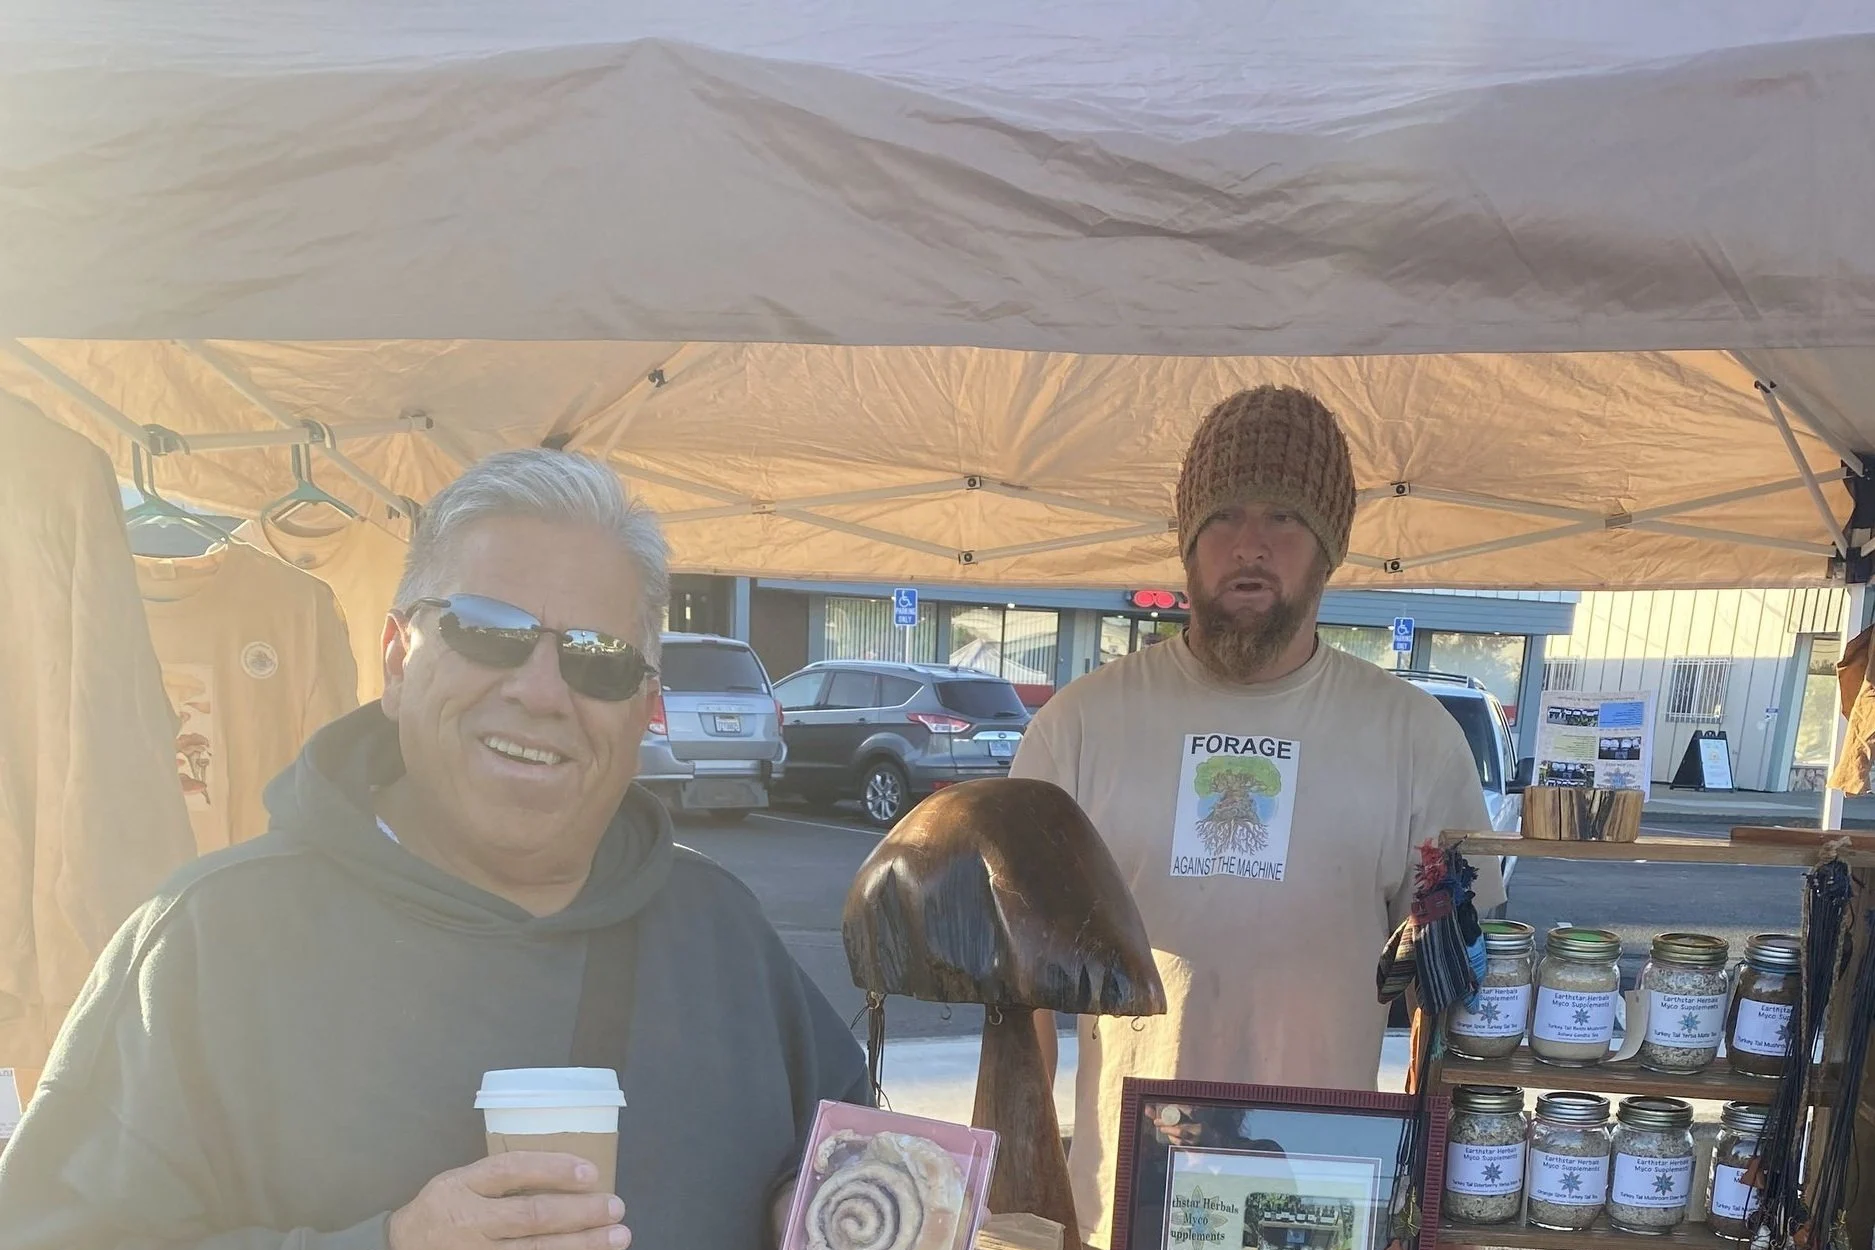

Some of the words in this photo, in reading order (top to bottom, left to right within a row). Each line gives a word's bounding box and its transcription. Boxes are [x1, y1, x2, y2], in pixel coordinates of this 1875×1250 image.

[1191, 735, 1292, 759] FORAGE
[1173, 856, 1217, 875] AGAINST
[1217, 856, 1236, 874] THE
[1237, 858, 1283, 880] MACHINE
[1555, 993, 1585, 1001] Earthstar
[1664, 995, 1694, 1003] Earthstar
[1680, 1003, 1719, 1011] Supplements
[1761, 1005, 1791, 1013] Earthsta
[1758, 1012, 1776, 1020] Myco
[1738, 1036, 1753, 1045] Turkey
[1545, 1155, 1576, 1163] Earthstar
[1637, 1158, 1668, 1166] Earthstar
[1543, 1161, 1560, 1169] Myco
[1562, 1164, 1600, 1172] Supplements
[1635, 1165, 1652, 1173] Myco
[1654, 1165, 1688, 1173] Supplements
[1172, 1198, 1200, 1208] thstar
[1204, 1198, 1239, 1214] Herbals
[1716, 1202, 1731, 1211] Turkey
[1184, 1213, 1209, 1226] Myco
[1171, 1230, 1225, 1242] upplements
